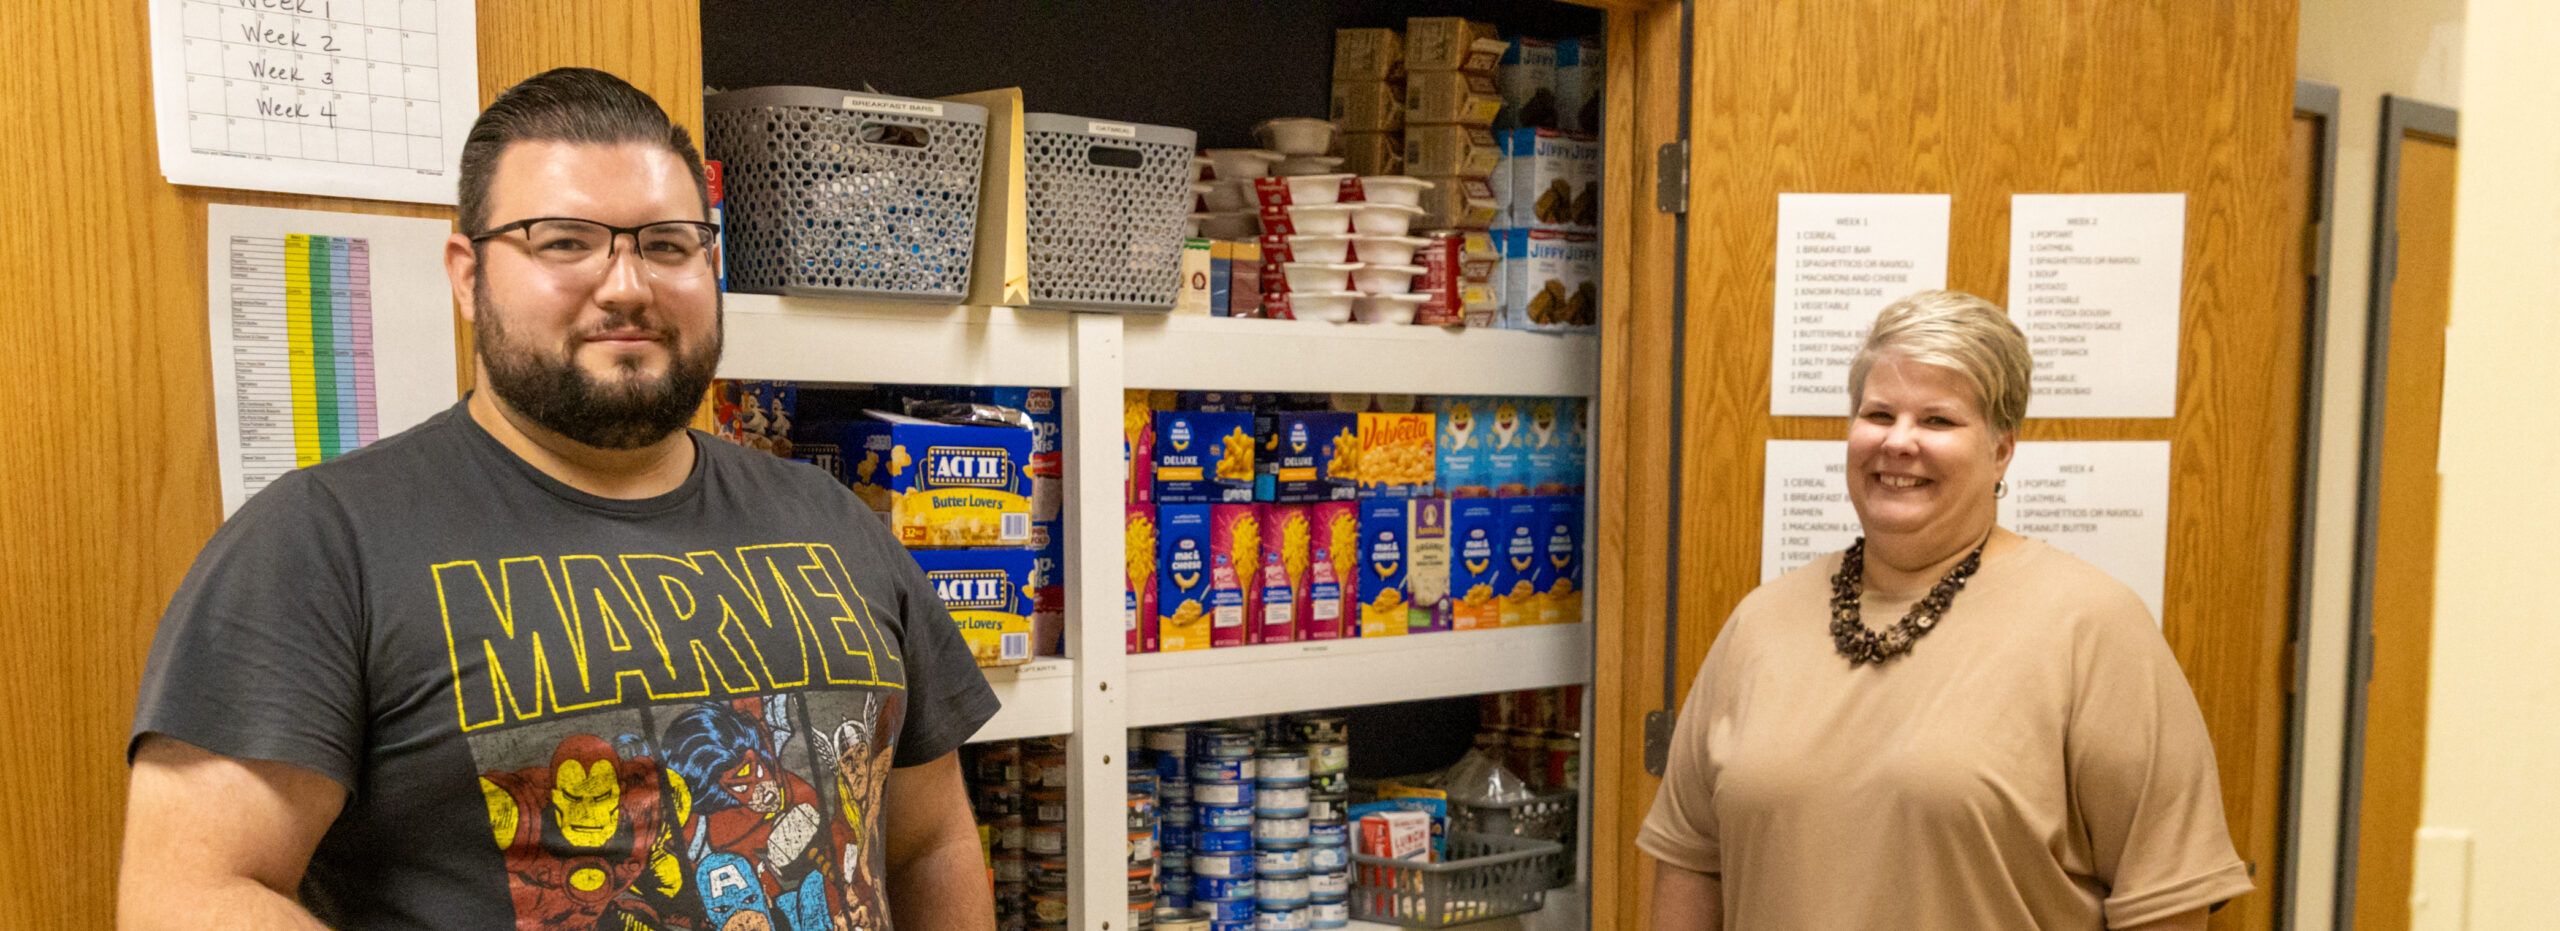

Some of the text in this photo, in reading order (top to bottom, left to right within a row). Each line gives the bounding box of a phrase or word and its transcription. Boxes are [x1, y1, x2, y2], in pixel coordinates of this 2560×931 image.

[241, 20, 342, 52] Week 2
[248, 58, 334, 85] Week 3
[852, 100, 906, 110] BREAKFAST
[256, 97, 337, 129] Week 4
[1096, 125, 1130, 133] OATMEAL
[1537, 142, 1570, 157] JIFFY
[1836, 218, 1860, 226] WEEK
[2067, 218, 2090, 226] WEEK
[1803, 232, 1836, 240] CEREAL
[1530, 242, 1565, 259] JIFFY
[1802, 246, 1852, 254] BREAKFAST
[1854, 246, 1871, 254] BAR
[2036, 244, 2073, 252] OATMEAL
[1802, 260, 1861, 268] SPAGHETTIOS
[1864, 260, 1877, 268] OR
[1802, 274, 1849, 282] MACARONI
[1852, 274, 1871, 282] AND
[1872, 274, 1907, 282] CHEESE
[2035, 270, 2058, 278] SOUP
[1801, 288, 1832, 296] KNORR
[1835, 288, 1861, 296] PASTA
[1863, 288, 1883, 296] SIDE
[1800, 302, 1850, 310] VEGETABLE
[1800, 316, 1823, 324] MEAT
[1799, 344, 1828, 352] SWEET
[1799, 358, 1824, 366] SALTY
[1798, 372, 1823, 380] FRUIT
[1797, 386, 1844, 394] PACKAGES
[1030, 390, 1050, 399] OPEN
[1034, 400, 1052, 408] FOLD
[1032, 422, 1056, 440] op
[1363, 416, 1428, 451] Velveeta
[1163, 456, 1198, 465] DELUXE
[1284, 456, 1313, 466] DELUXE
[936, 456, 999, 478] ACT II
[1825, 464, 1846, 473] WEE
[2059, 465, 2085, 473] WEEK
[1790, 479, 1826, 487] CEREAL
[2024, 480, 2066, 488] POPTART
[932, 494, 1003, 509] Butter Lovers
[1790, 493, 1842, 502] BREAKFAST
[2024, 494, 2066, 503] OATMEAL
[1789, 508, 1823, 516] RAMEN
[2090, 509, 2104, 518] OR
[1789, 523, 1839, 531] MACARONI
[2023, 524, 2059, 532] PEANUT
[2062, 524, 2097, 532] BUTTER
[905, 527, 916, 538] 32
[1788, 537, 1809, 546] RICE
[937, 579, 998, 600] ACT II
[969, 616, 1003, 630] Lovers
[431, 541, 906, 733] MARVEL
